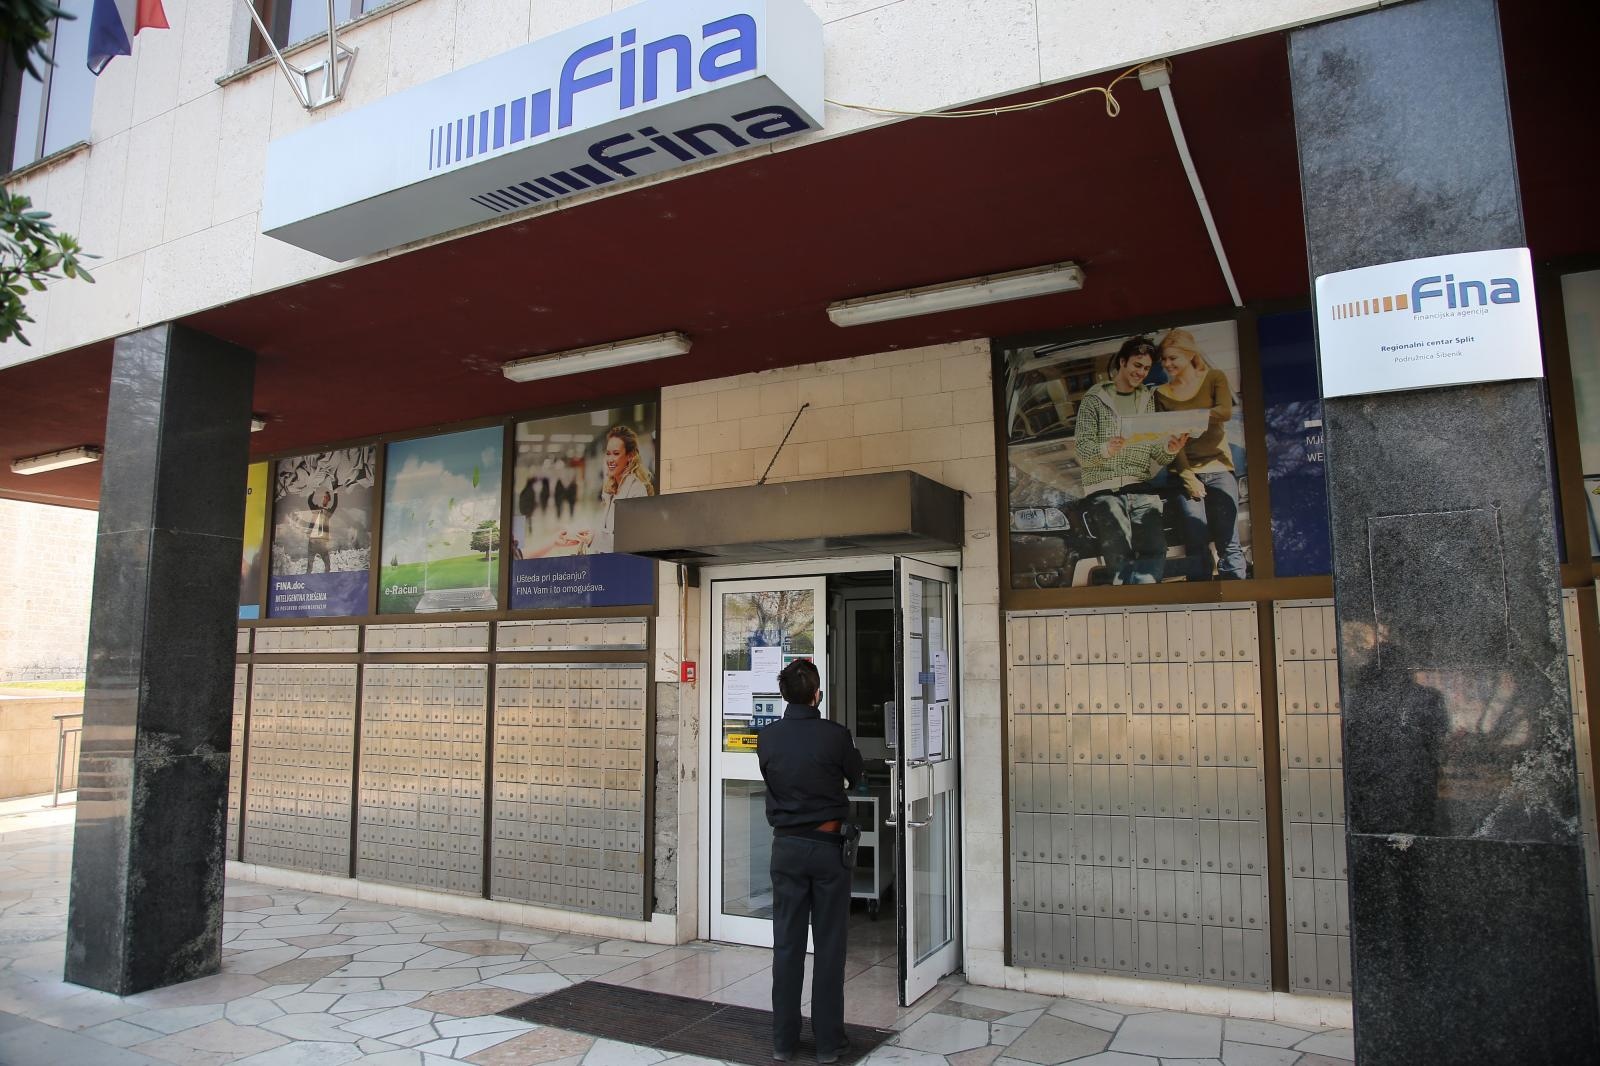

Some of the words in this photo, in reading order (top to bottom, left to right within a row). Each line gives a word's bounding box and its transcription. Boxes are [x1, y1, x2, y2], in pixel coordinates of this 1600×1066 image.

[558, 13, 757, 130] Fina
[588, 105, 811, 177] Fina
[1411, 273, 1521, 313] Fina
[1413, 311, 1455, 321] Financijska
[1457, 307, 1489, 317] agencija
[1381, 341, 1424, 352] Regionalni
[1426, 338, 1453, 347] centar
[1455, 335, 1475, 345] Split
[1394, 354, 1434, 364] Podružnica
[1436, 350, 1463, 360] Šibenik
[516, 573, 540, 583] Ušteda
[541, 572, 551, 584] pri
[552, 570, 587, 582] plaćanju?
[275, 580, 305, 591] FINA.doc
[384, 583, 418, 596] e-Račun
[516, 586, 532, 596] FINA
[533, 586, 549, 595] Vam
[553, 584, 561, 594] to
[562, 583, 605, 594] omogućava.
